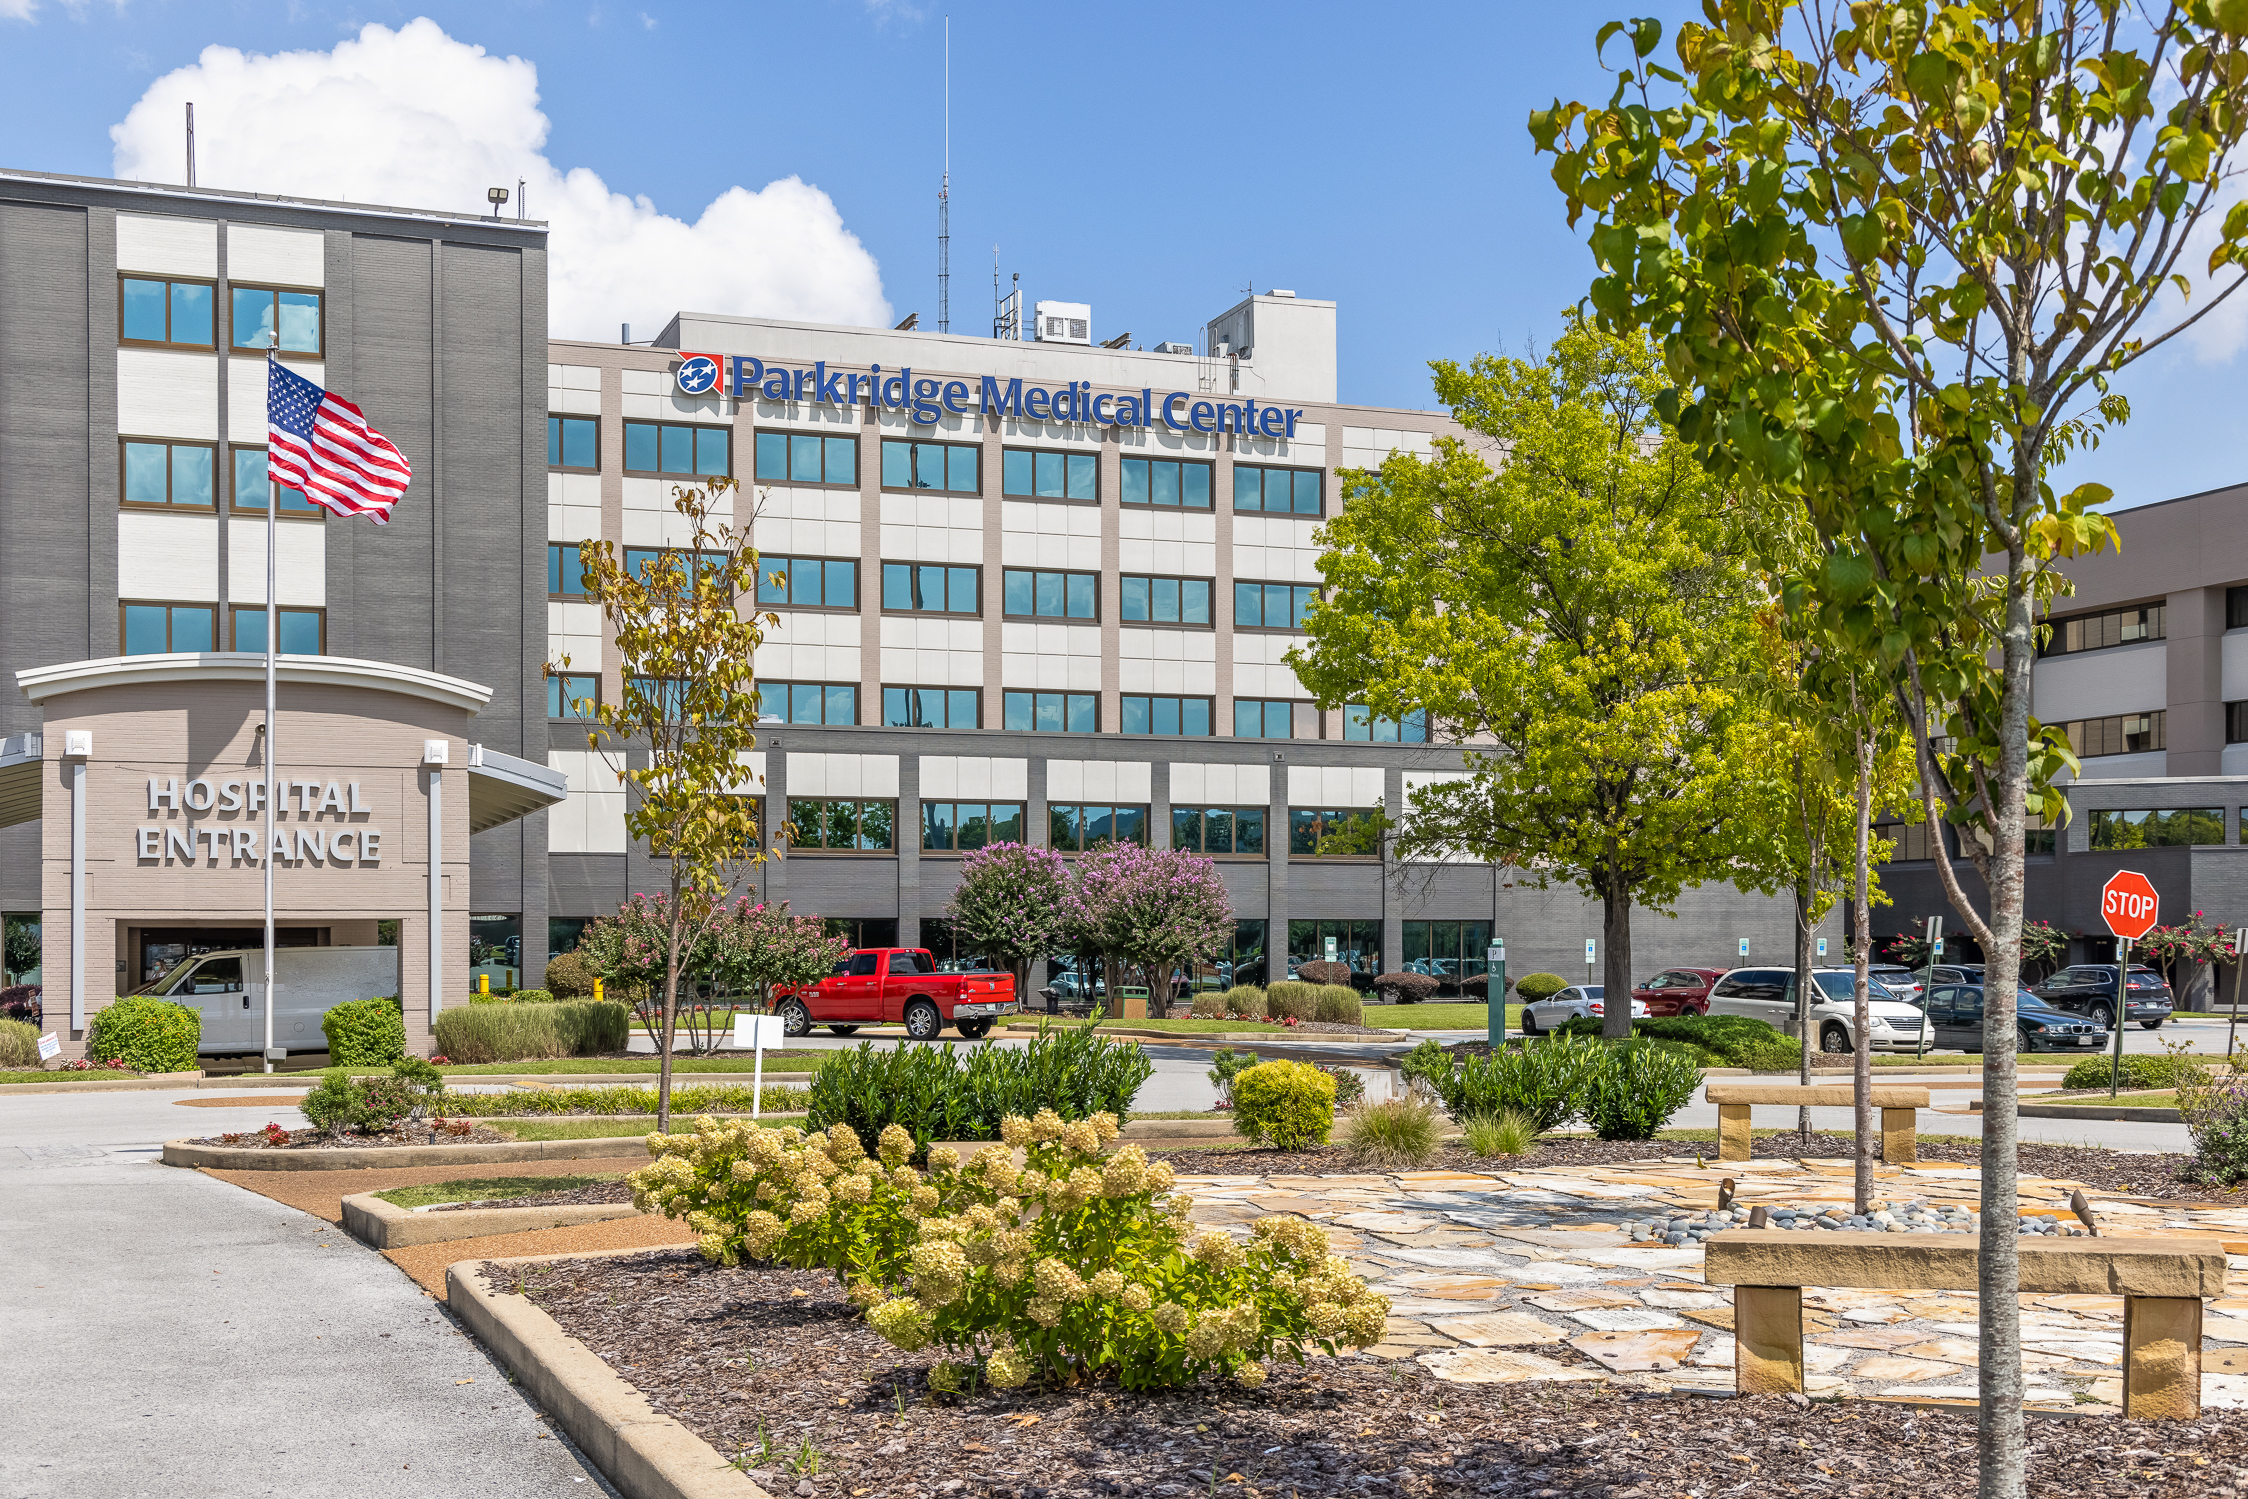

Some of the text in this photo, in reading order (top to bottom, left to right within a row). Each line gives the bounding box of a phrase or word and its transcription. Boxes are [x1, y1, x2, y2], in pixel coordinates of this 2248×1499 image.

[731, 355, 1303, 438] Parkridge Medical Center
[149, 778, 372, 813] HOSPITAL
[138, 827, 381, 861] ENTRANCE
[2105, 889, 2155, 920] STOP
[1492, 949, 1497, 959] P
